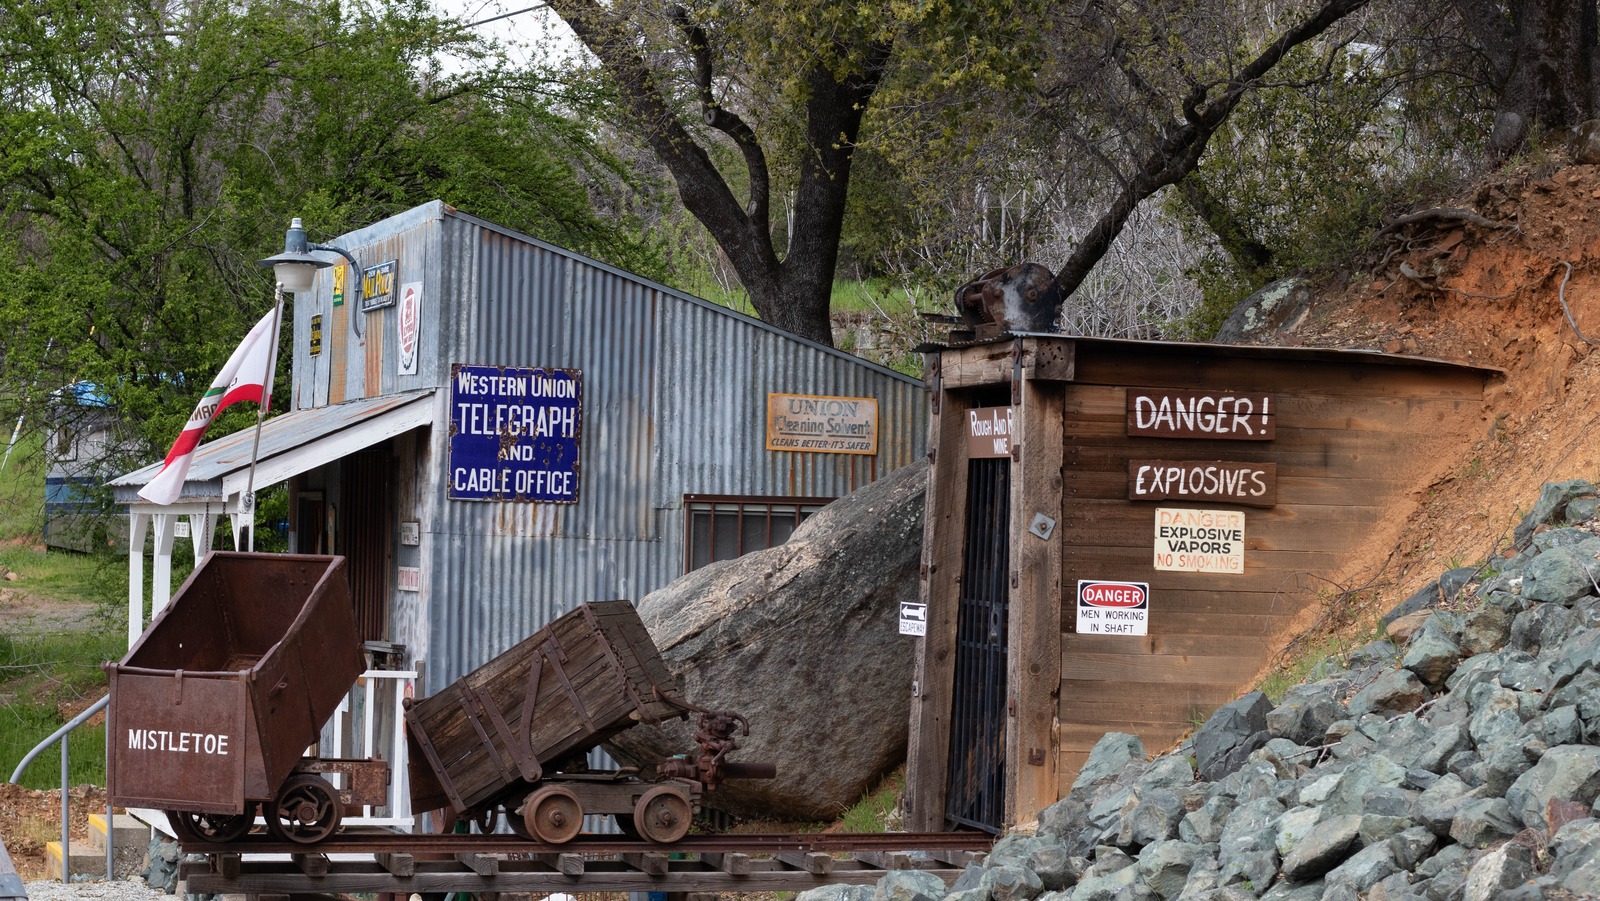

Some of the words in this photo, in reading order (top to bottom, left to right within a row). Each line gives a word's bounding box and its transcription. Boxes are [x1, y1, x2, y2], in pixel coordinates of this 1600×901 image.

[458, 371, 527, 396] WESTERN
[531, 375, 576, 399] UNION
[787, 398, 859, 417] UNION
[1135, 396, 1269, 435] DANGER!
[458, 402, 576, 438] TELEGRAPH
[775, 415, 824, 436] Cleaning
[826, 418, 871, 435] Solvent
[970, 410, 993, 437] ROUGH
[993, 409, 1007, 436] AND
[771, 438, 799, 447] CLEANS
[801, 439, 829, 448] BETTER
[845, 441, 871, 450] SAFER
[993, 438, 1009, 454] MINE
[497, 445, 534, 461] AND
[454, 467, 511, 493] CABLE
[515, 469, 573, 495] OFFICE
[1135, 465, 1267, 497] EXPLOSIVES
[1159, 511, 1239, 528] DANGER
[1160, 526, 1242, 541] EXPLOSIVE
[1167, 540, 1232, 554] VAPORS
[1157, 553, 1173, 567] NO
[1178, 554, 1239, 570] SMOKING
[1086, 588, 1141, 603] DANGER
[1081, 609, 1100, 619] MEN
[1105, 610, 1144, 621] WORKING
[1090, 623, 1100, 632] IN
[1104, 623, 1134, 634] SHAFT
[128, 729, 229, 755] MISTLETOE
